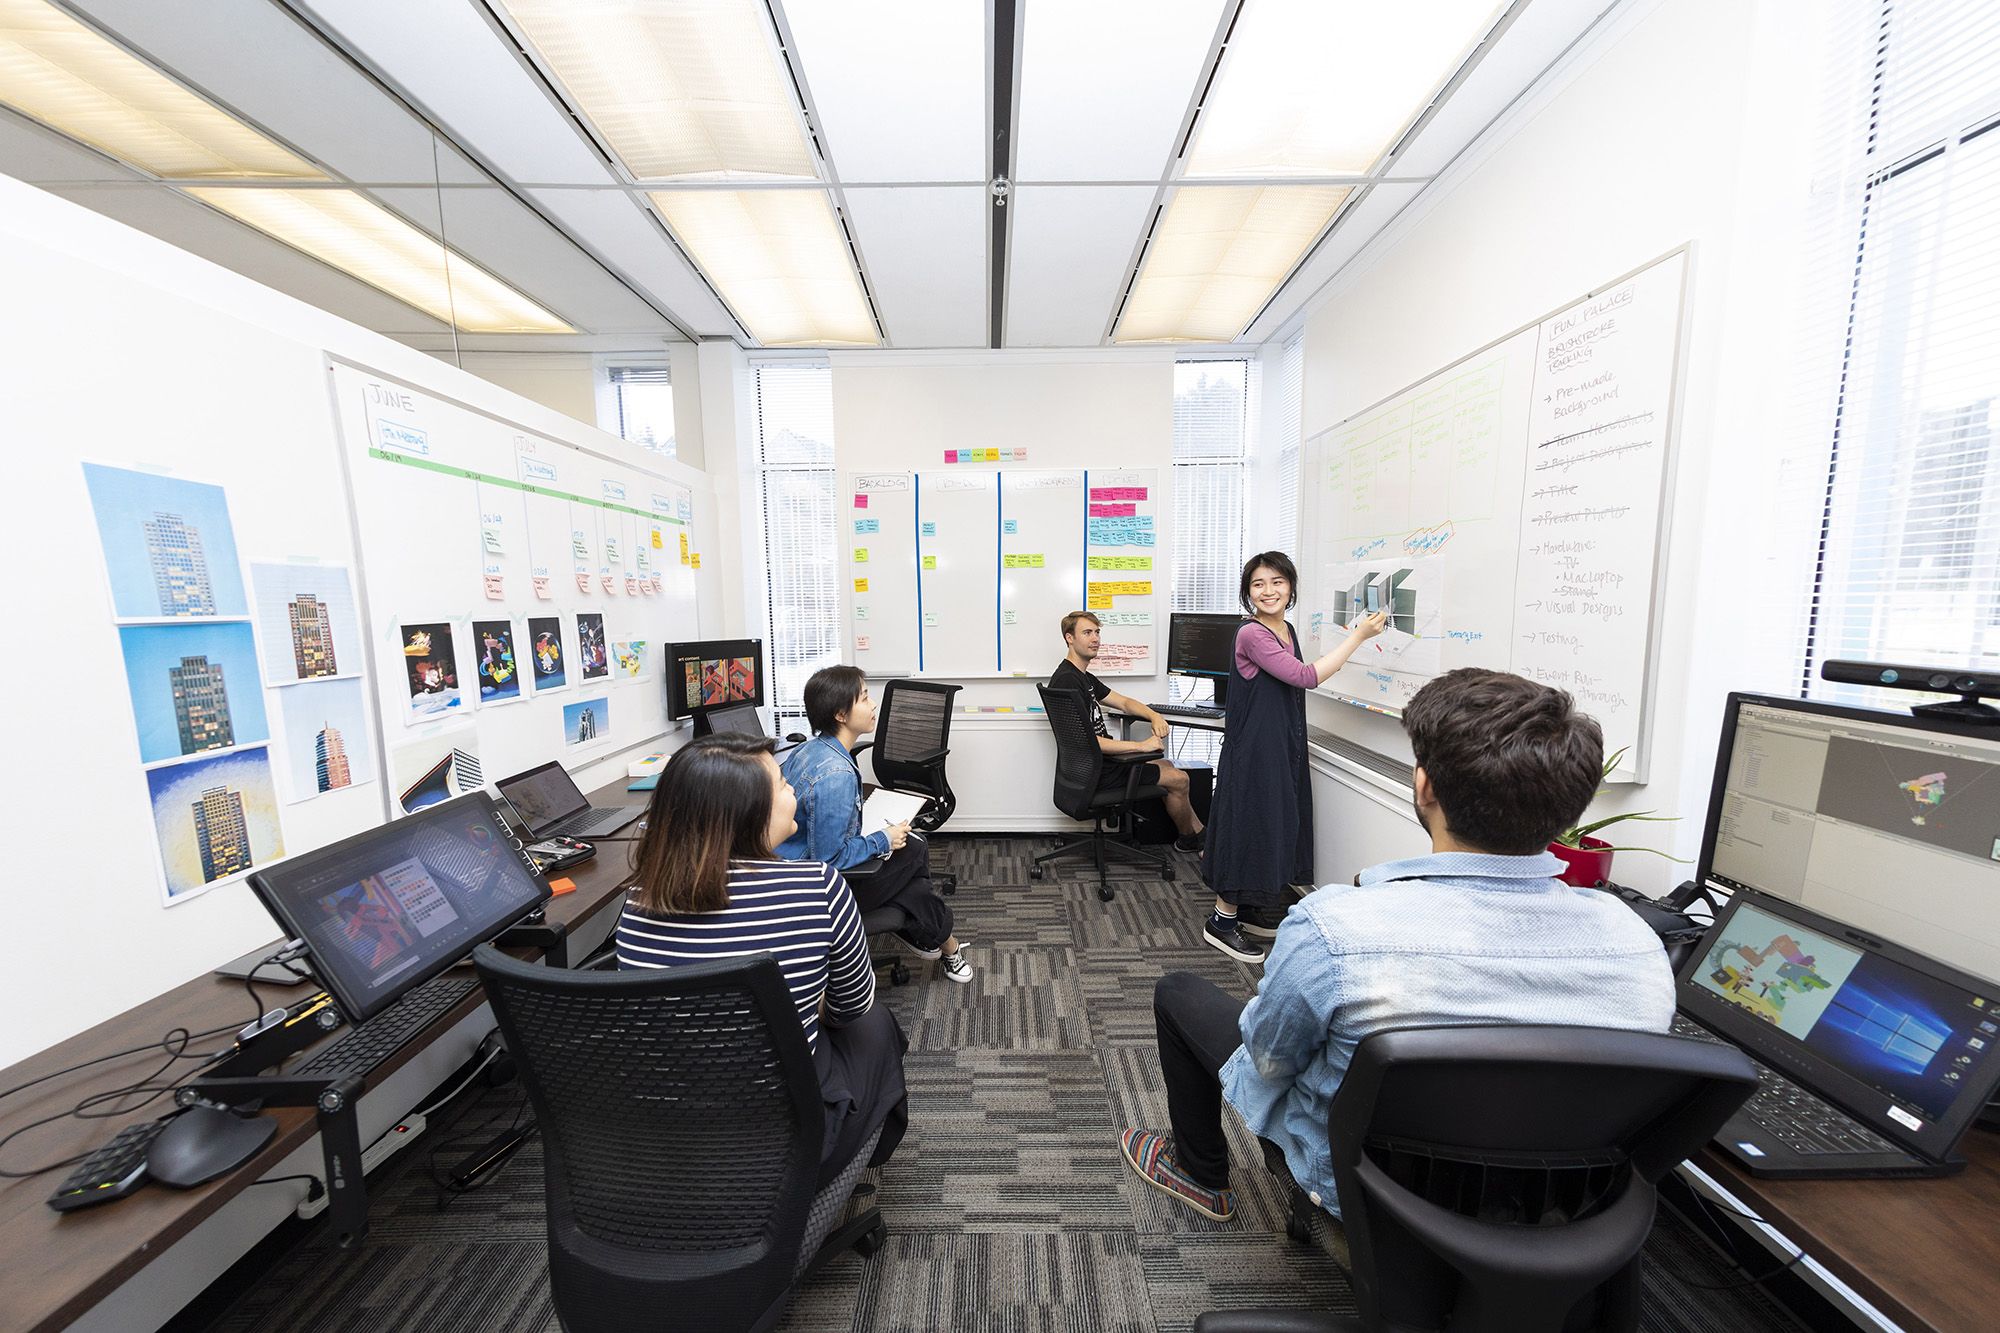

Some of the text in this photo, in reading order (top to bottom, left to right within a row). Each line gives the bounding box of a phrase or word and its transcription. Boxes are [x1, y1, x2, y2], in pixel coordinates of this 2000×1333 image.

[1553, 288, 1631, 335] FUN PALACE
[1548, 318, 1616, 359] BRUSHSTROKE
[1548, 345, 1593, 373] TRACKING
[368, 383, 415, 412] JUNE
[1556, 369, 1616, 401] Pre-made
[1553, 384, 1620, 419] Background
[858, 478, 906, 490] BACKLOG
[1545, 600, 1623, 622] Visual Designs
[1540, 632, 1584, 655] Testing
[1536, 666, 1570, 682] Event
[1578, 686, 1628, 713] through
